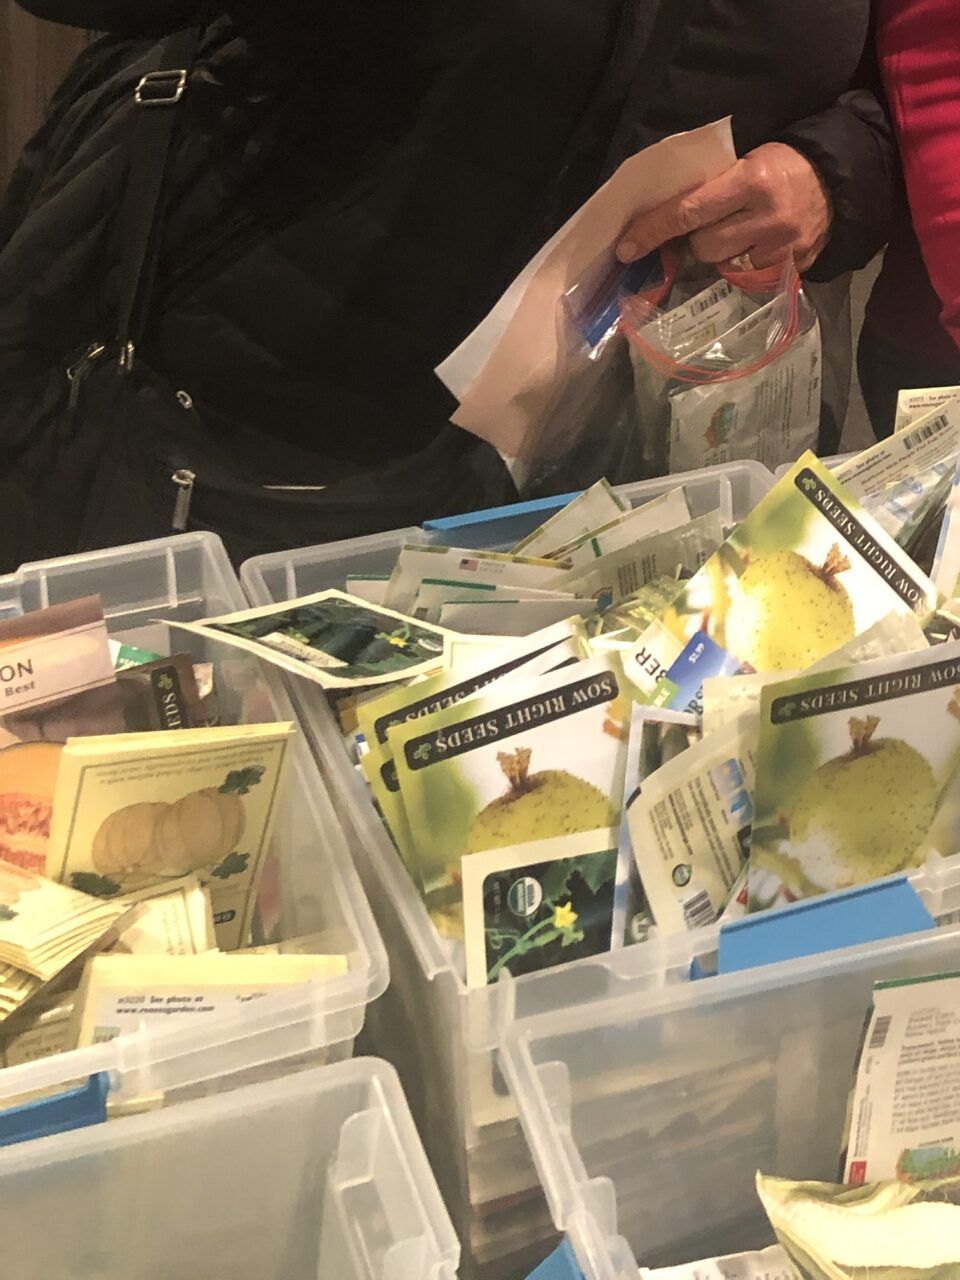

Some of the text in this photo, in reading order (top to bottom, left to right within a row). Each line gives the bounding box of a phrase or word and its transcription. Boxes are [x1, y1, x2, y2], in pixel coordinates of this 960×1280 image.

[814, 489, 857, 536] SEEDS
[854, 534, 897, 580] RIGHT
[0, 658, 35, 683] ON
[5, 680, 37, 698] Best
[800, 686, 860, 712] SEEDS
[865, 673, 922, 699] RIGHT
[435, 678, 613, 753] SOW RIGHT SEEDS
[166, 995, 192, 1005] photo
